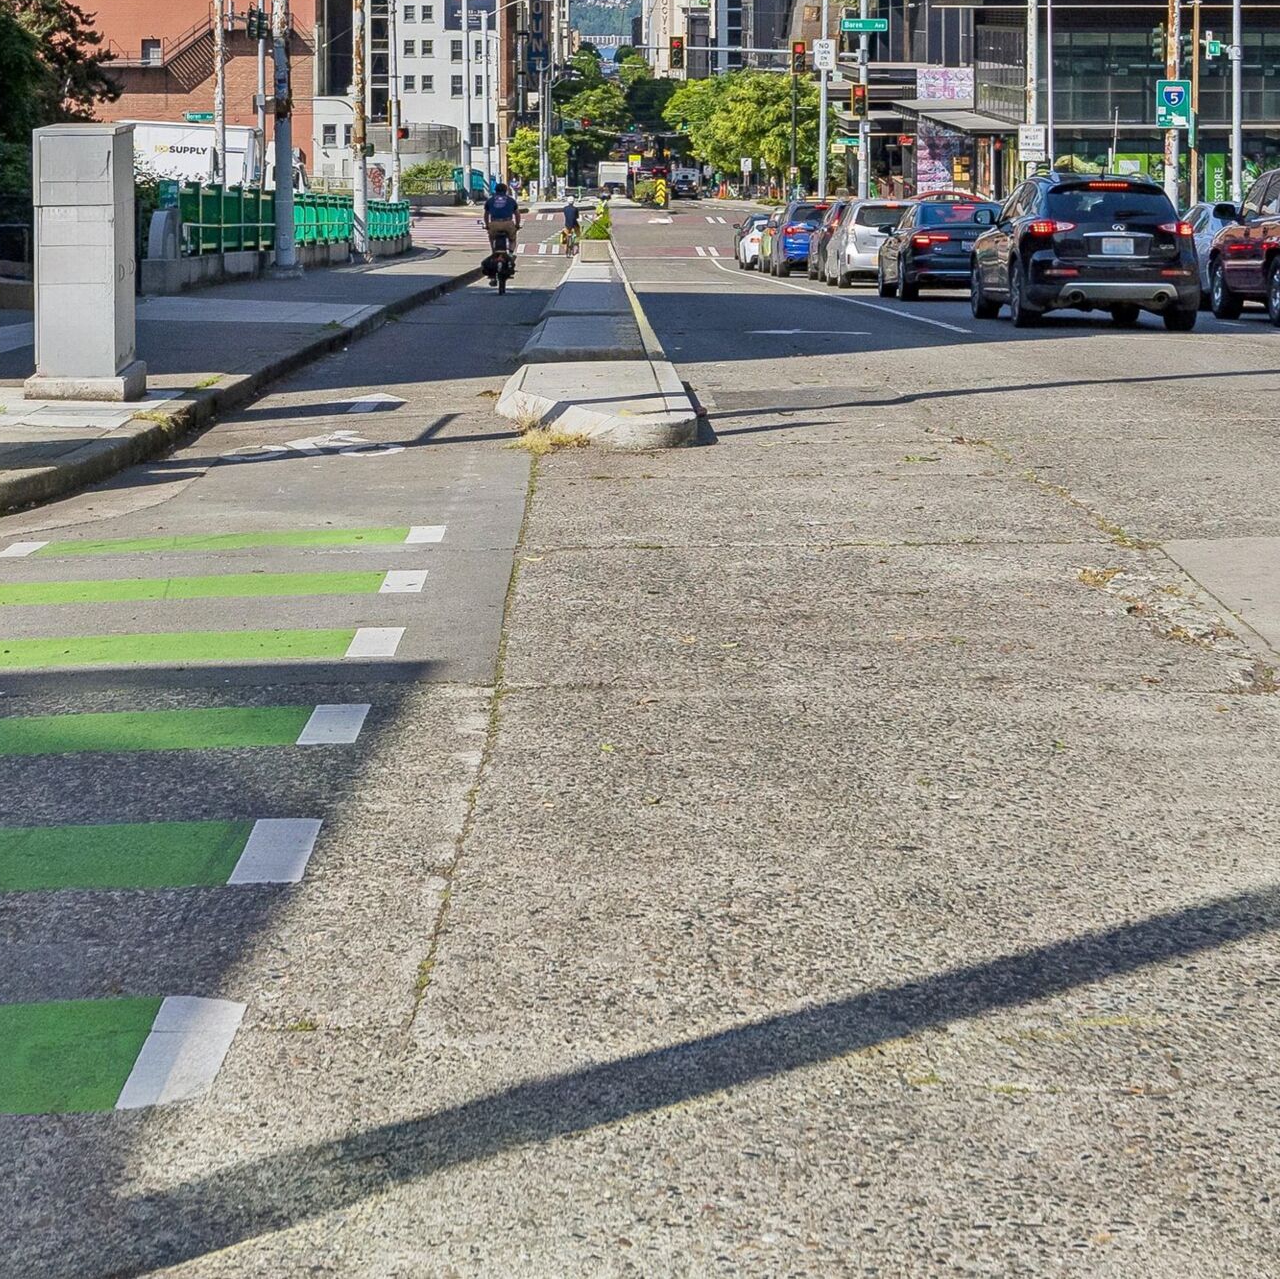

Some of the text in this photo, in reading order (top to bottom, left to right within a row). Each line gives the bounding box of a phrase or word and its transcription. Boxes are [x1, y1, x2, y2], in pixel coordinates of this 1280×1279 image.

[844, 21, 863, 29] Boren
[1170, 92, 1179, 105] 5
[169, 145, 208, 155] SUPPLY
[1214, 167, 1224, 202] STORE
